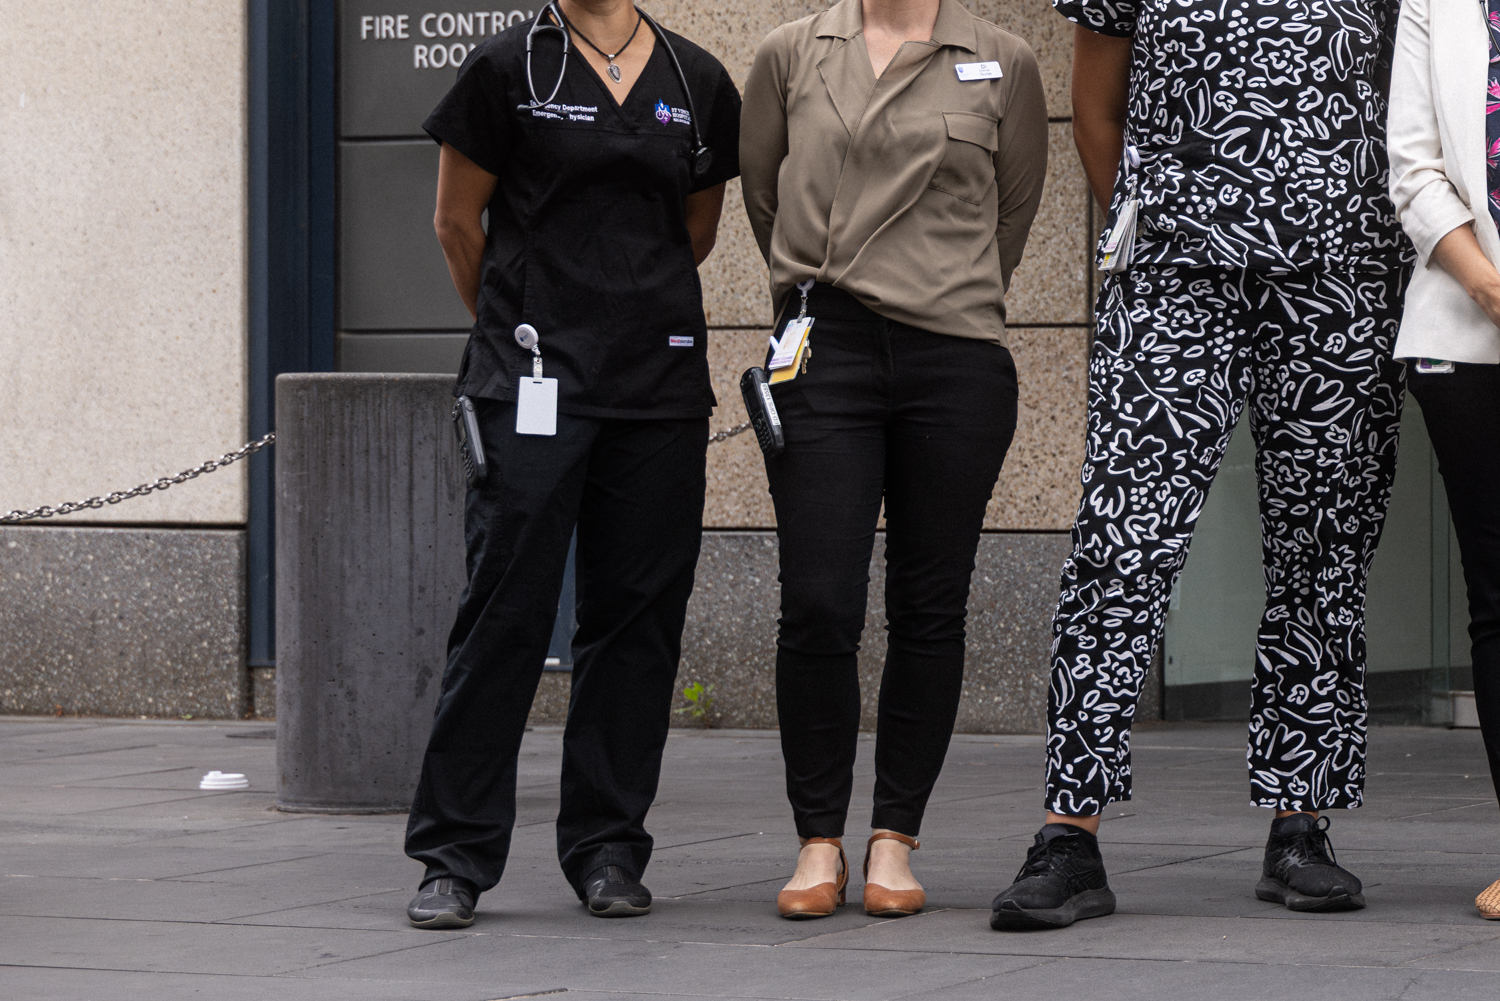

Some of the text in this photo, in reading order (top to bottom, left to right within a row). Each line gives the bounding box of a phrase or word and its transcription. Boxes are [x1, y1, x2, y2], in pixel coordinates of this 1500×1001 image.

[361, 14, 410, 40] FIRE
[414, 43, 476, 69] ROO
[562, 104, 598, 113] Department
[569, 113, 595, 121] hysician
